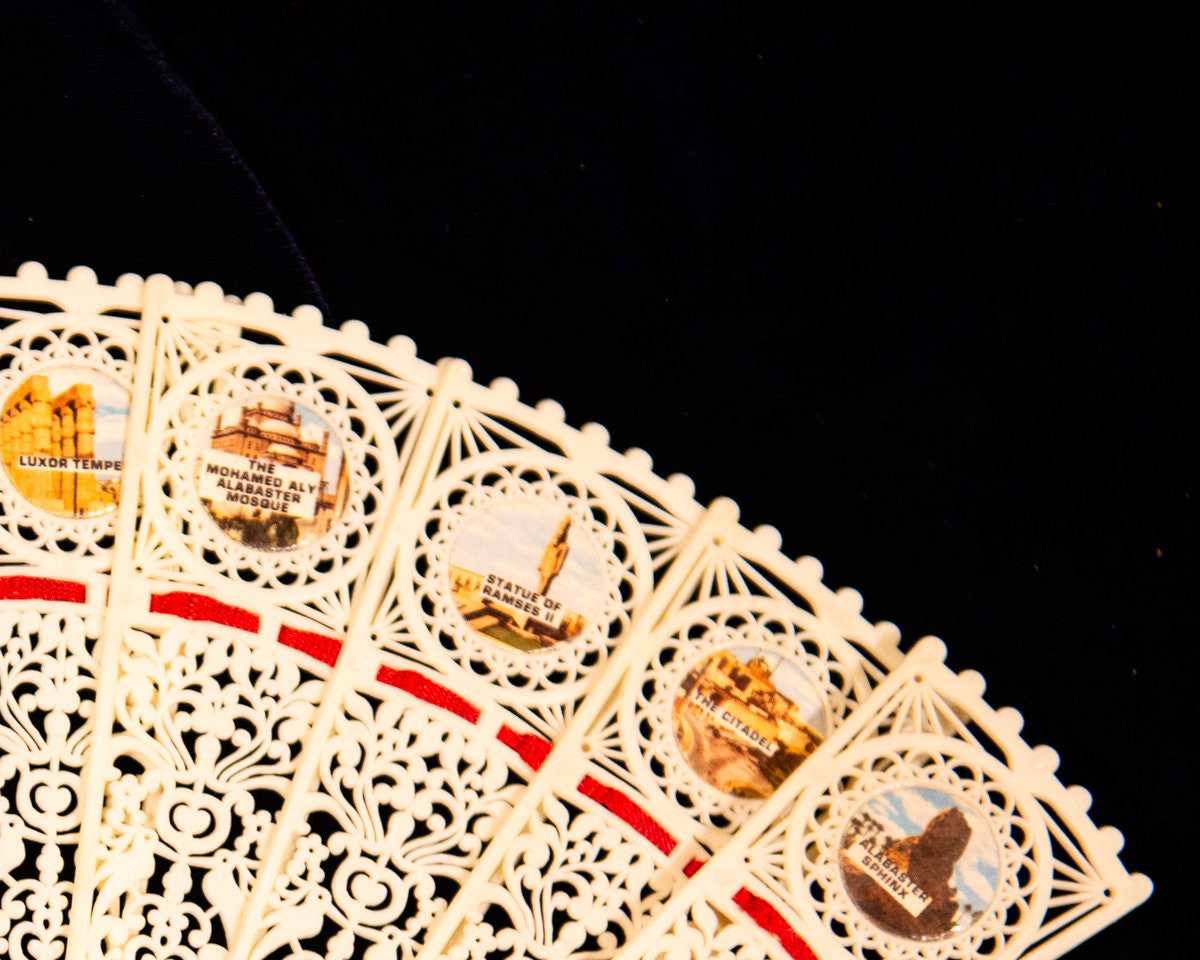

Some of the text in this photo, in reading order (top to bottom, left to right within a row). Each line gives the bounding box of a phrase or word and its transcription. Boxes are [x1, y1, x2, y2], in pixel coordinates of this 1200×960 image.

[19, 456, 122, 471] LUXOR TEMPE
[206, 463, 316, 494] MOHAMED ALY
[248, 459, 275, 474] THE
[216, 477, 301, 504] ALABASTER
[226, 491, 289, 513] MOSQUE
[482, 584, 555, 623] RAMSES II
[486, 573, 562, 611] STATUE OF
[695, 690, 772, 751] THE CITADEL
[859, 839, 929, 903] ALABASTER
[861, 855, 909, 899] SPHINX
